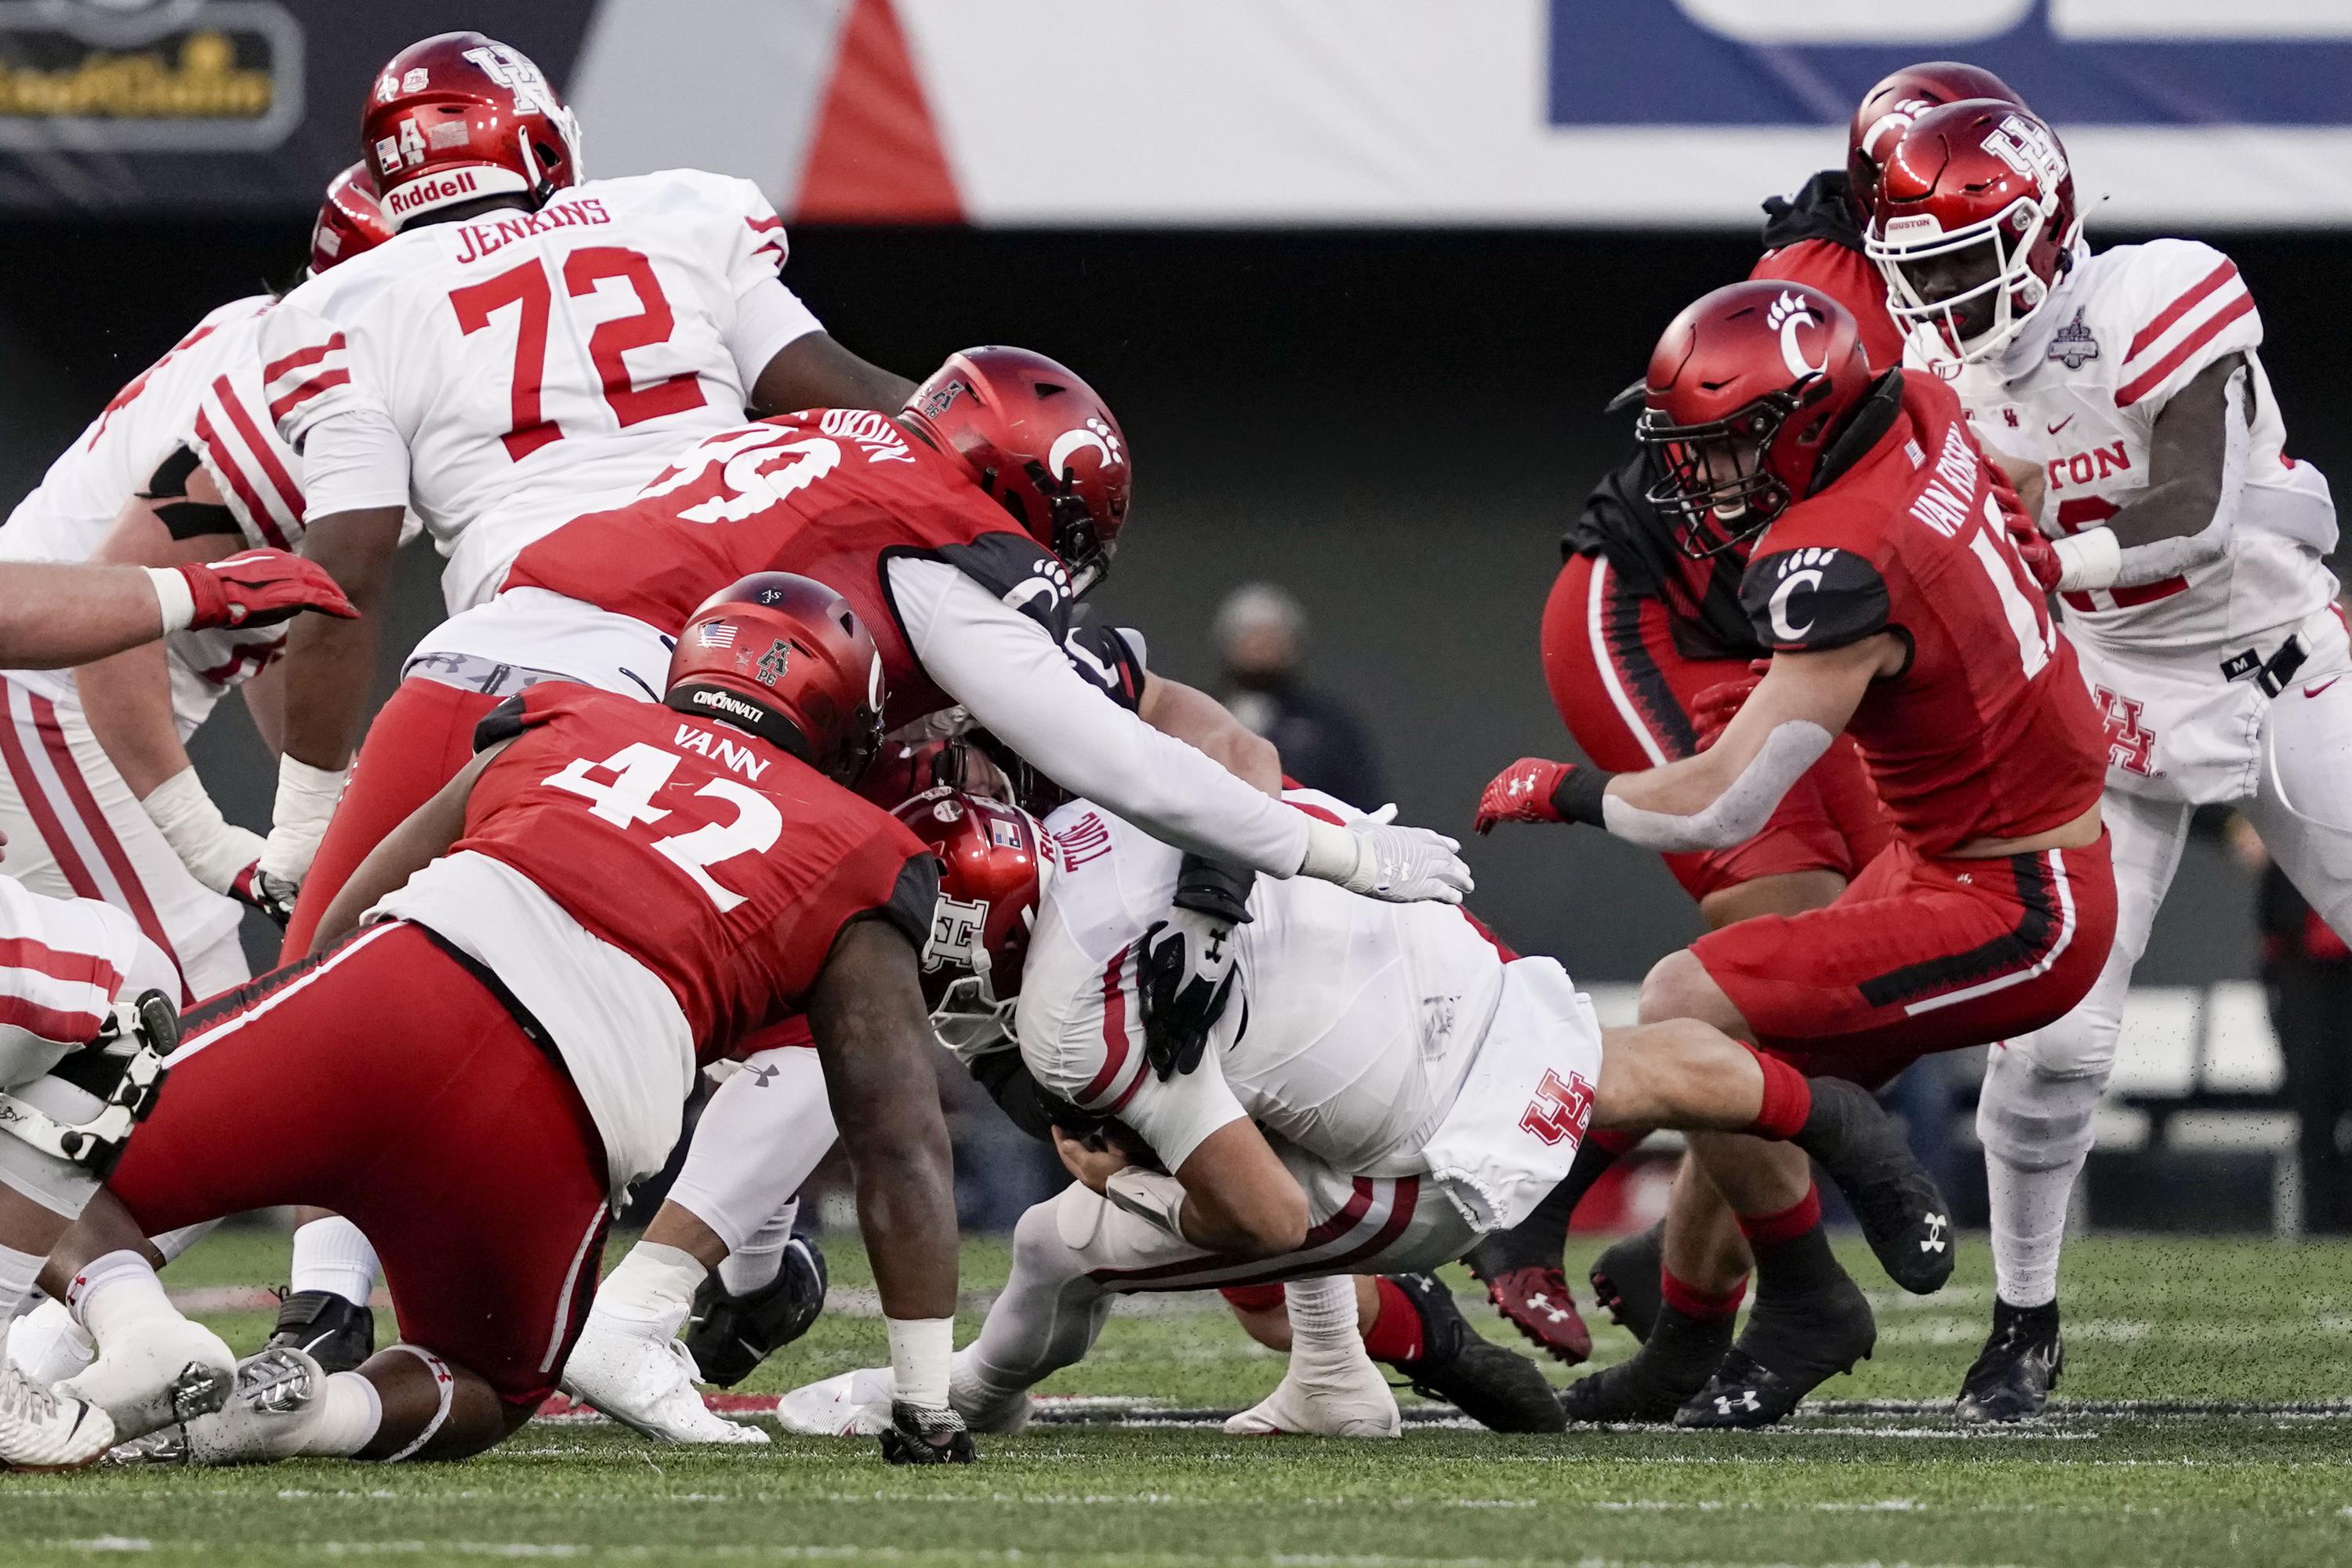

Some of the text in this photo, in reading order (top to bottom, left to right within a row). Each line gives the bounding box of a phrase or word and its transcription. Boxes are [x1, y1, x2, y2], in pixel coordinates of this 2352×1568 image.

[389, 172, 477, 216] Riddell
[457, 199, 610, 264] JENKINS
[1888, 219, 1930, 230] HOUSTON
[448, 246, 708, 463] 72
[1909, 479, 1969, 539] VAN
[693, 691, 764, 723] CINCINNATI
[673, 724, 771, 782] VANN
[540, 742, 782, 913] 42
[1053, 811, 1112, 873] TUNE
